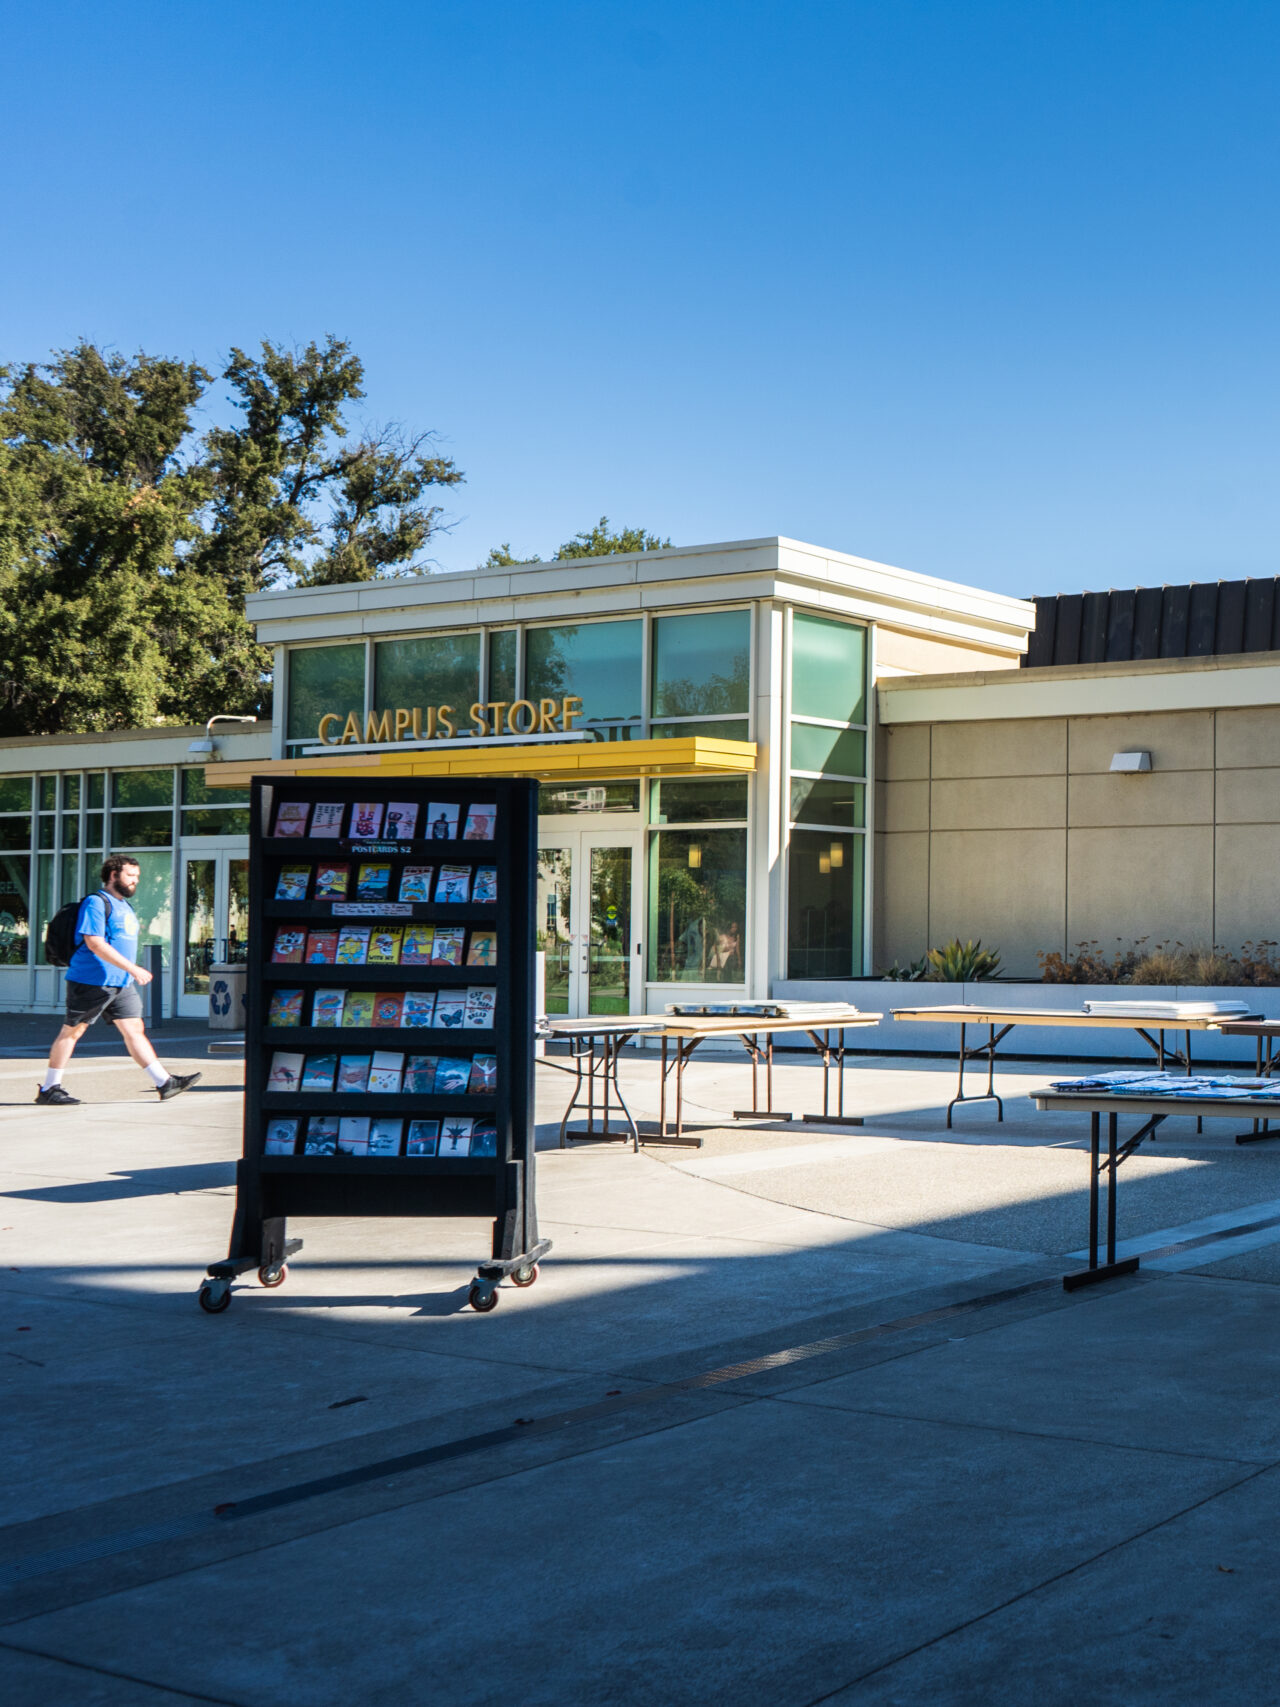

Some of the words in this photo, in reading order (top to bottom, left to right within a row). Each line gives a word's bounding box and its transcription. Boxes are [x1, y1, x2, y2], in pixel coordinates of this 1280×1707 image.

[318, 705, 457, 745] CAMPUS
[470, 697, 584, 737] STORE
[351, 845, 398, 853] POSTCARDS
